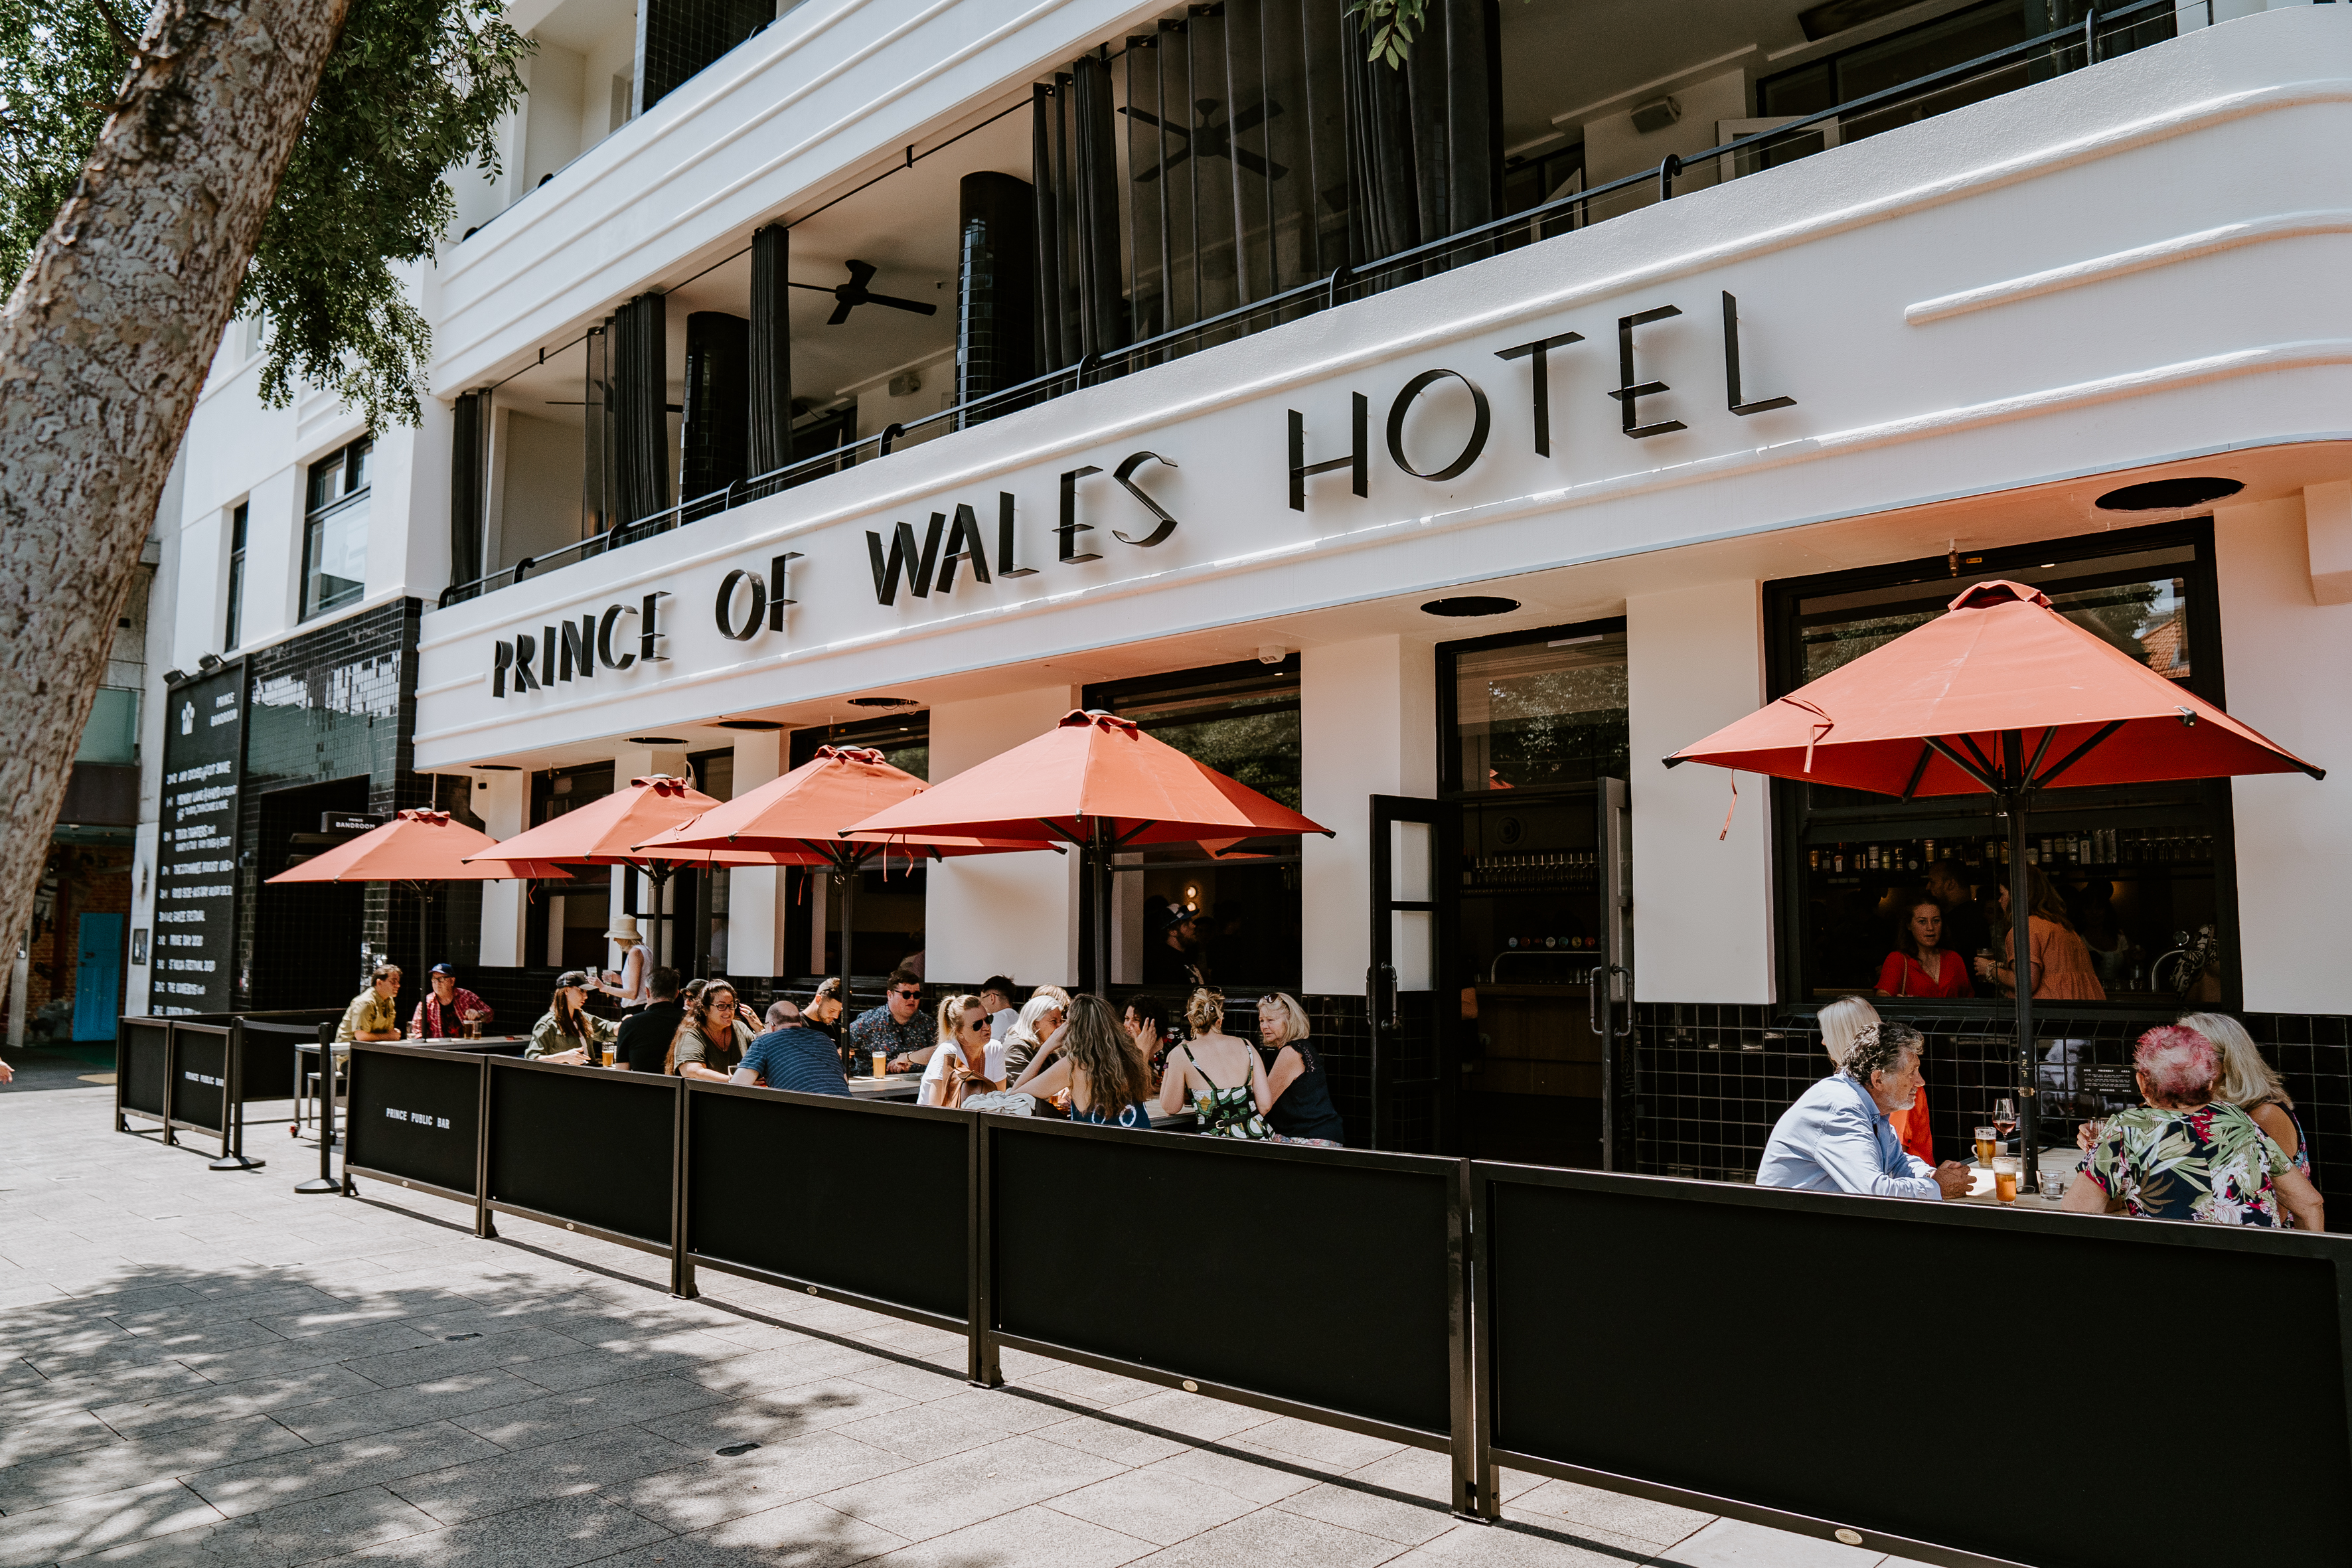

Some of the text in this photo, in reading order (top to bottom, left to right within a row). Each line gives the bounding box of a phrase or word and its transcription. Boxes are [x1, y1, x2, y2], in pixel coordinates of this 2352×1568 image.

[493, 290, 1797, 698] PRINCE OF WALES HOTEL
[386, 1107, 450, 1129] PRINCE PUBLIC BAR
